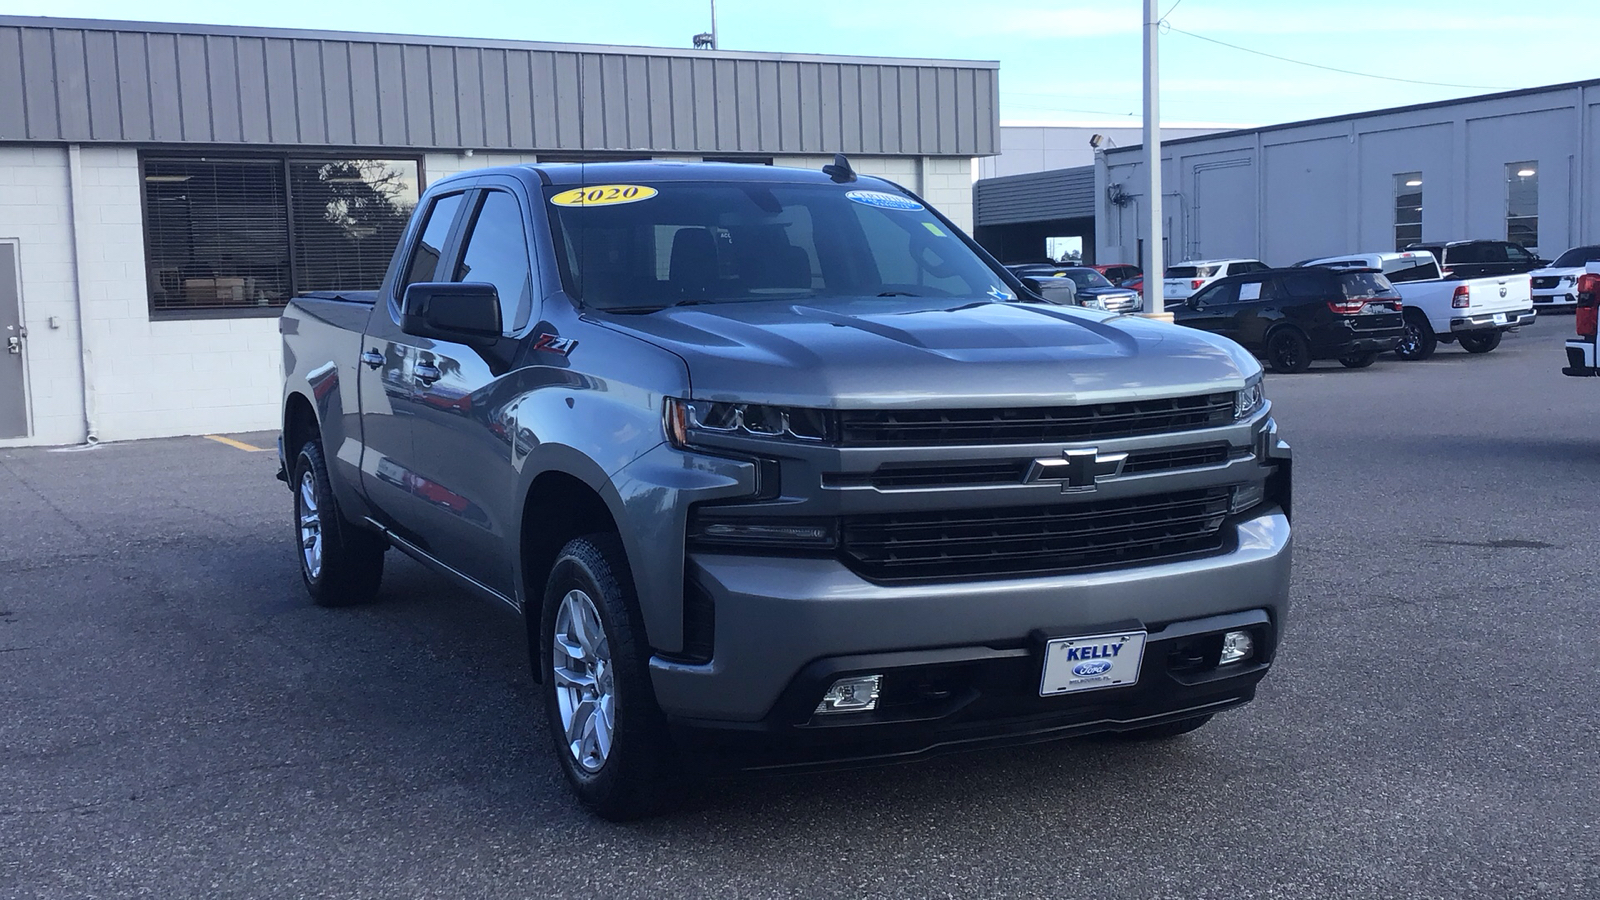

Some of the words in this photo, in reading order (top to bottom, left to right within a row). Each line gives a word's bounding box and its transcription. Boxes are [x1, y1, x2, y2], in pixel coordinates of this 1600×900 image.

[570, 187, 638, 203] 2020
[533, 332, 580, 357] Z71
[1067, 643, 1123, 661] KELLY
[1080, 664, 1104, 674] Ford
